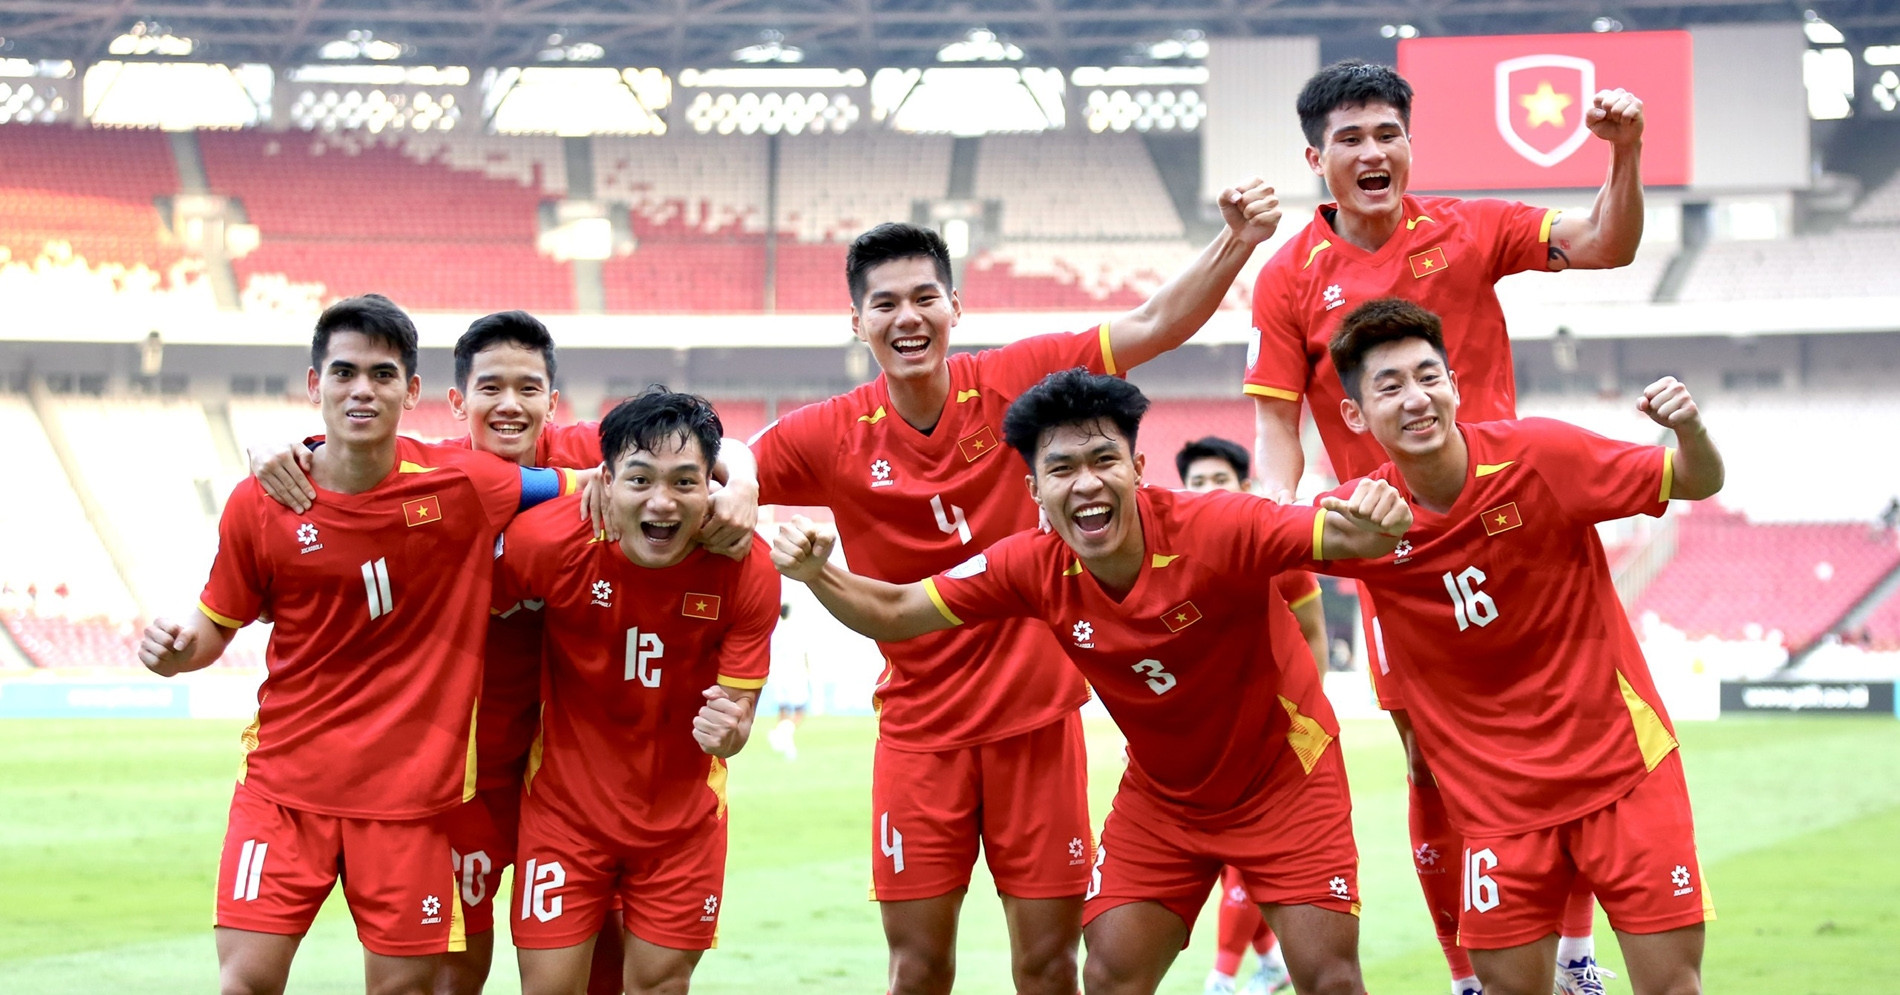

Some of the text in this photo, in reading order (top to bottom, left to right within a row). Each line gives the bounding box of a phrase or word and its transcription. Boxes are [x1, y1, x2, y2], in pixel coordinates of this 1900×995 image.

[930, 494, 972, 544] 4
[361, 557, 392, 620] 11
[1443, 566, 1498, 631] 16
[624, 627, 664, 688] 12
[1132, 659, 1176, 695] 3
[233, 840, 268, 902] 11
[881, 812, 905, 873] 4
[521, 858, 566, 923] 12
[1464, 848, 1499, 913] 16
